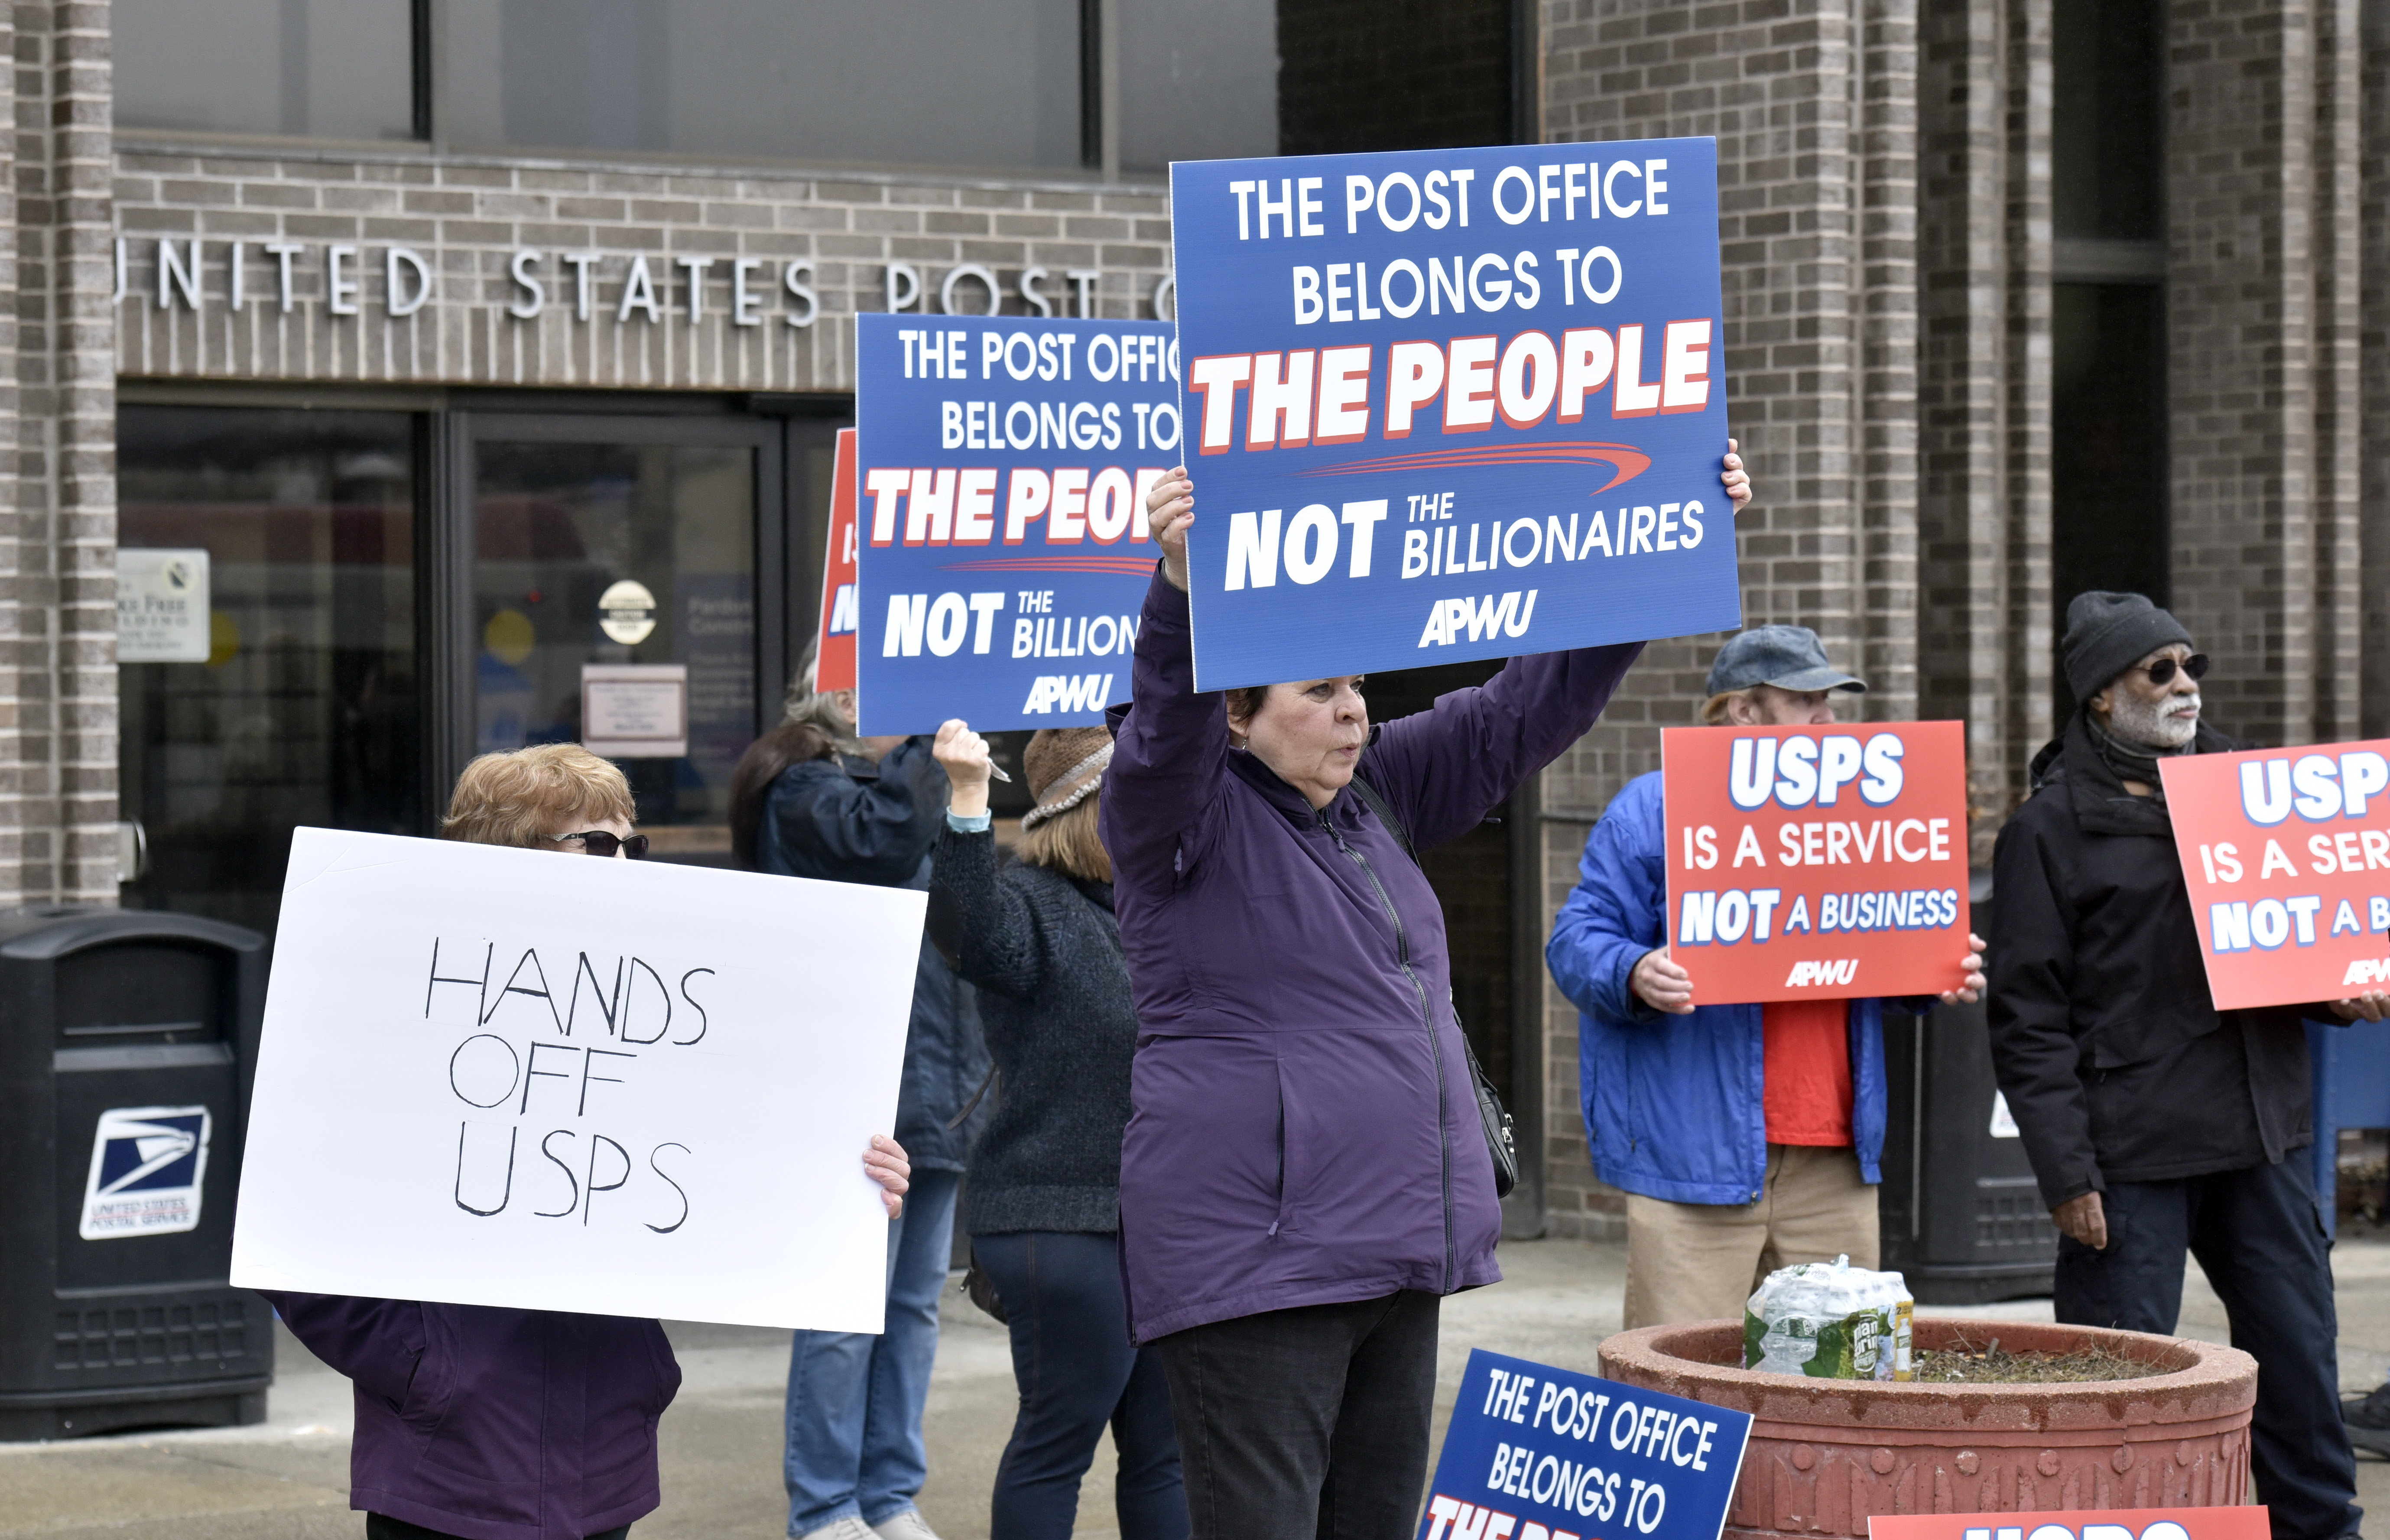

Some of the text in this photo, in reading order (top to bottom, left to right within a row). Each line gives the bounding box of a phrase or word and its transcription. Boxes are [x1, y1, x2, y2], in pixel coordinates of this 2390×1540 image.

[1230, 159, 1669, 240] THE POST OFFICE
[510, 249, 820, 328] STATES
[887, 263, 1101, 320] POST
[1292, 246, 1623, 325] BELONGS TO
[899, 329, 967, 379] THE
[982, 331, 1076, 381] POST
[1189, 318, 1712, 456] THE PEOPLE
[942, 401, 1181, 451] BELONGS TO
[864, 468, 998, 548] THE
[1224, 492, 1455, 591] NOT THE
[1401, 500, 1704, 579] BILLIONAIRES
[882, 590, 1054, 658] NOT THE
[1418, 589, 1539, 649] APWU
[1023, 673, 1114, 715] APWU
[1728, 732, 1904, 812] USPS
[1684, 818, 1950, 870] IS A SERVICE
[2199, 841, 2244, 884] IS
[2260, 838, 2299, 880] A
[1677, 888, 1958, 947] NOT A BUSINESS
[2210, 895, 2321, 955] NOT
[2330, 899, 2361, 938] A
[425, 936, 715, 1046] HANDS
[1785, 959, 1859, 988] APWU
[449, 1033, 638, 1117] OFF
[455, 1121, 692, 1234] USPS
[1483, 1368, 1718, 1472] THE POST OFFICE
[1487, 1442, 1666, 1534] BELONGS TO
